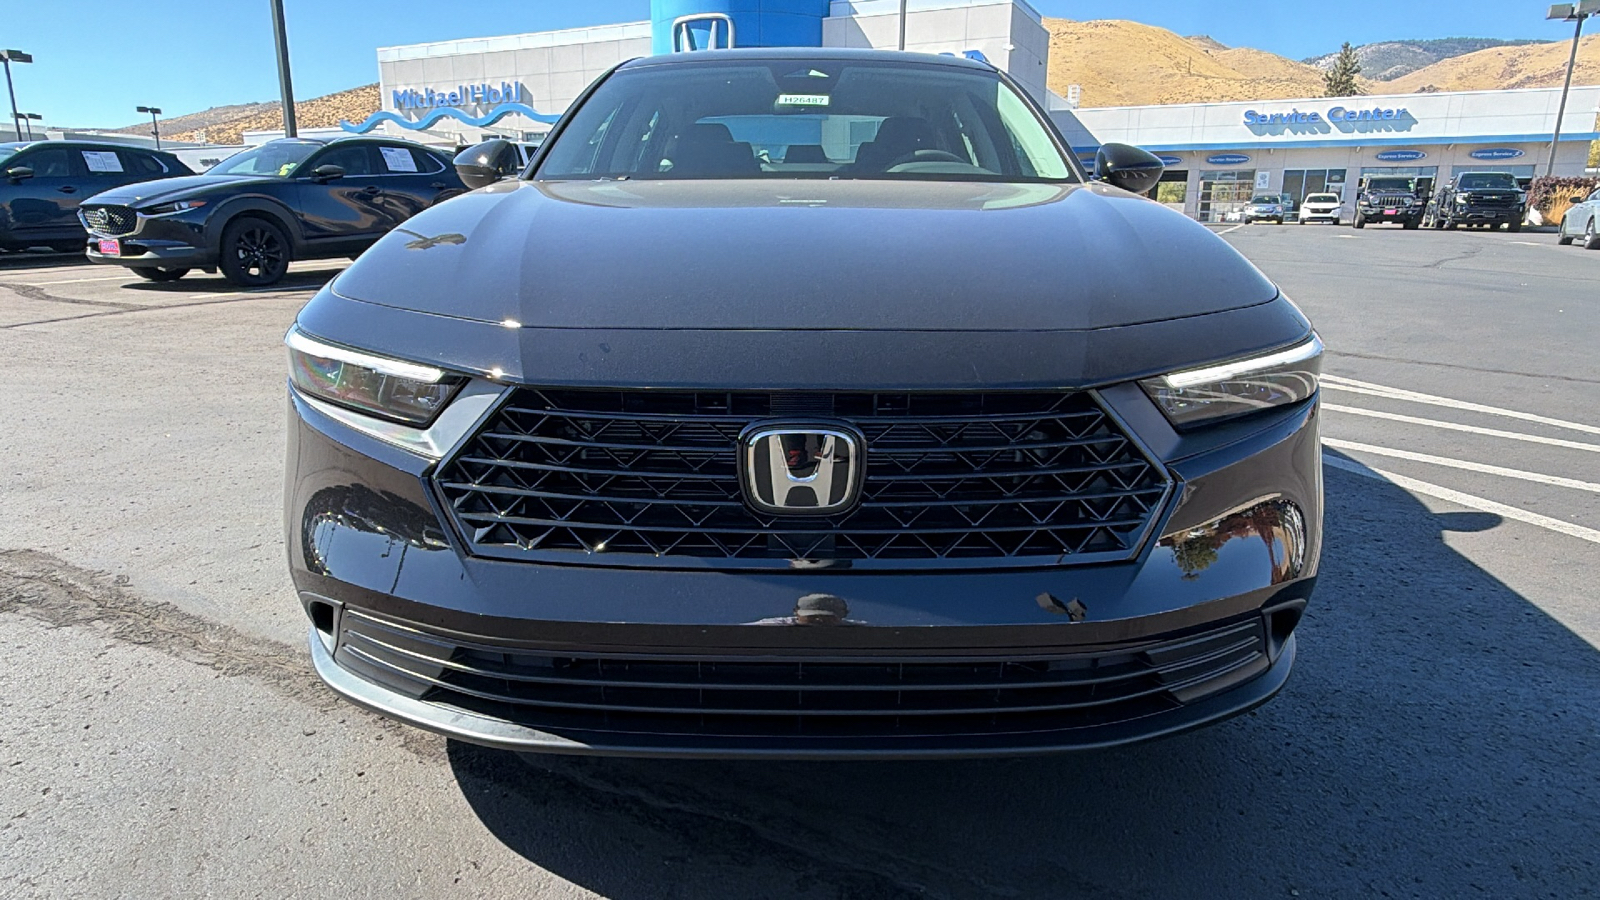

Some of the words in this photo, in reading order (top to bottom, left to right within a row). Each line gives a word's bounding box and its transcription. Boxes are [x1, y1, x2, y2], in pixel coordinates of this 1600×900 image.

[392, 85, 465, 109] Michael
[470, 81, 521, 103] Hohl
[1243, 108, 1320, 126] Service
[1327, 106, 1407, 122] Center
